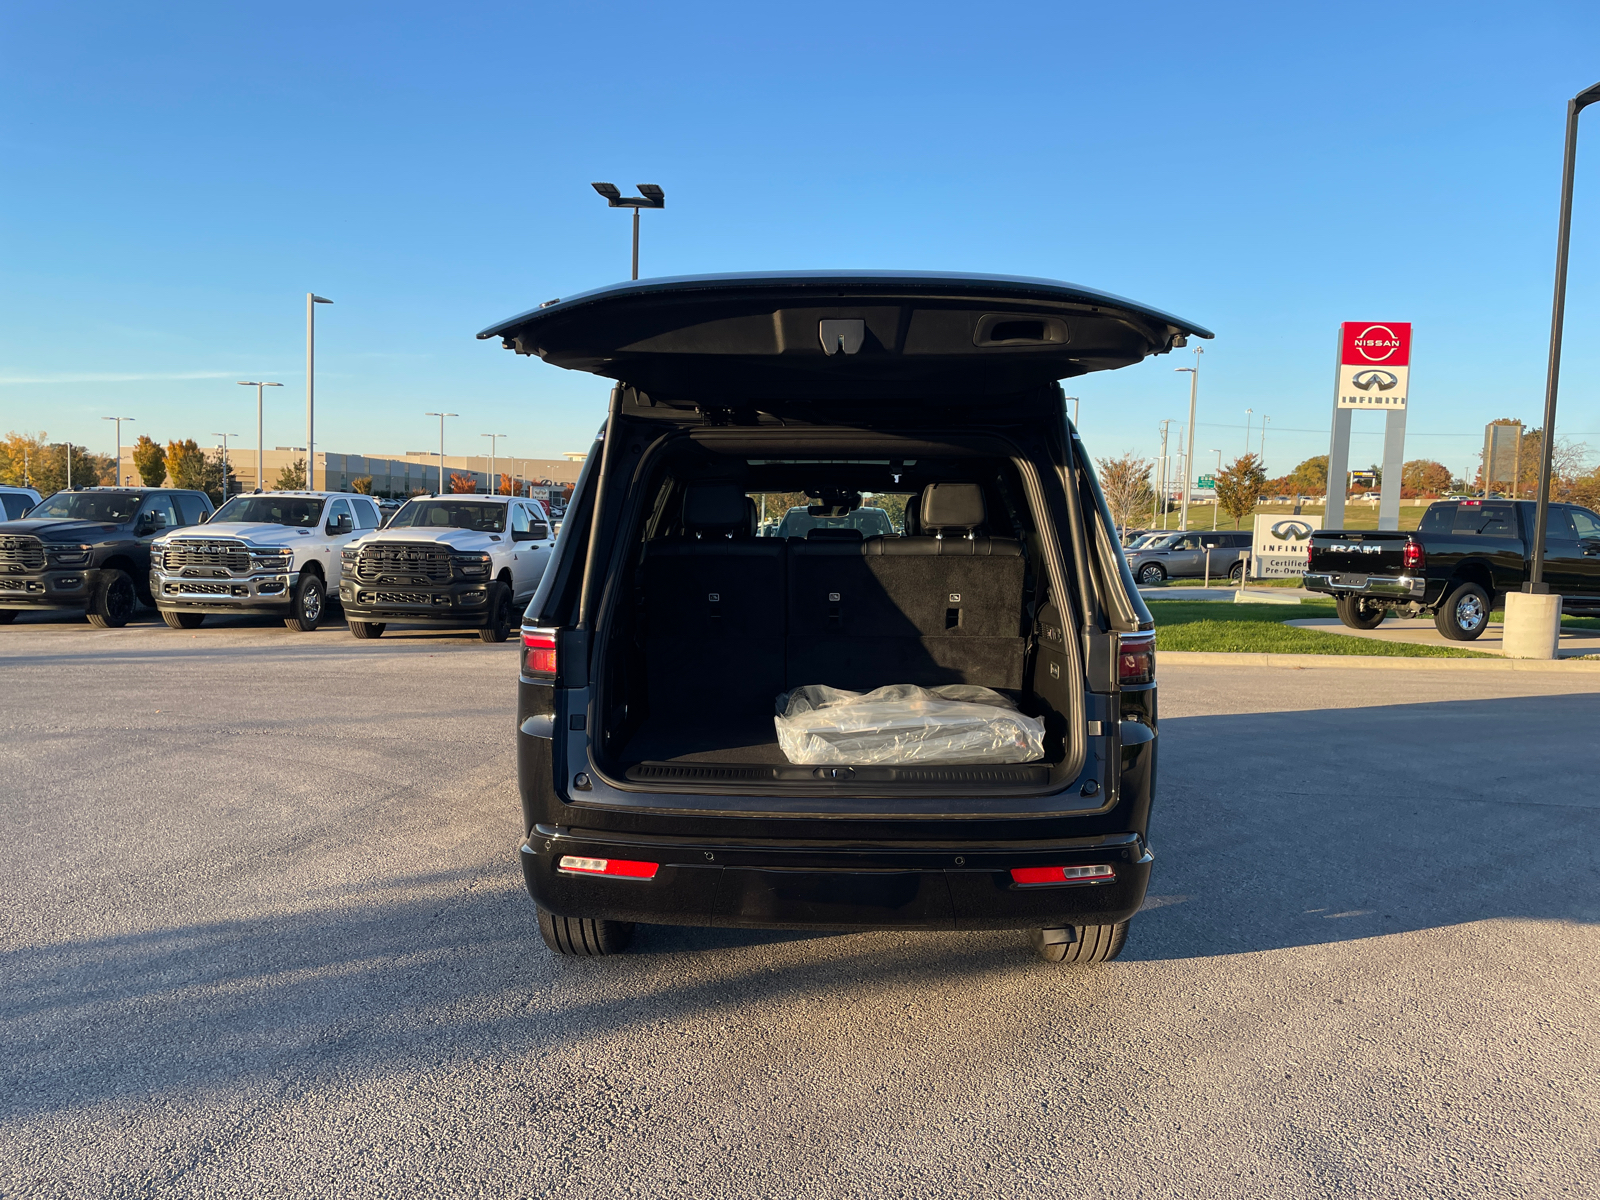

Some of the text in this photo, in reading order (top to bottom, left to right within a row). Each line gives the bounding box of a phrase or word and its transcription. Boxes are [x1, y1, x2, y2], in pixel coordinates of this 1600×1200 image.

[1354, 339, 1400, 347] NISSAN
[1341, 396, 1406, 405] INFINITI
[1262, 544, 1310, 553] INFINI
[1330, 544, 1382, 555] RAM
[380, 551, 427, 560] RAM
[1270, 559, 1308, 567] Certified
[1265, 567, 1305, 575] Pre-Own
